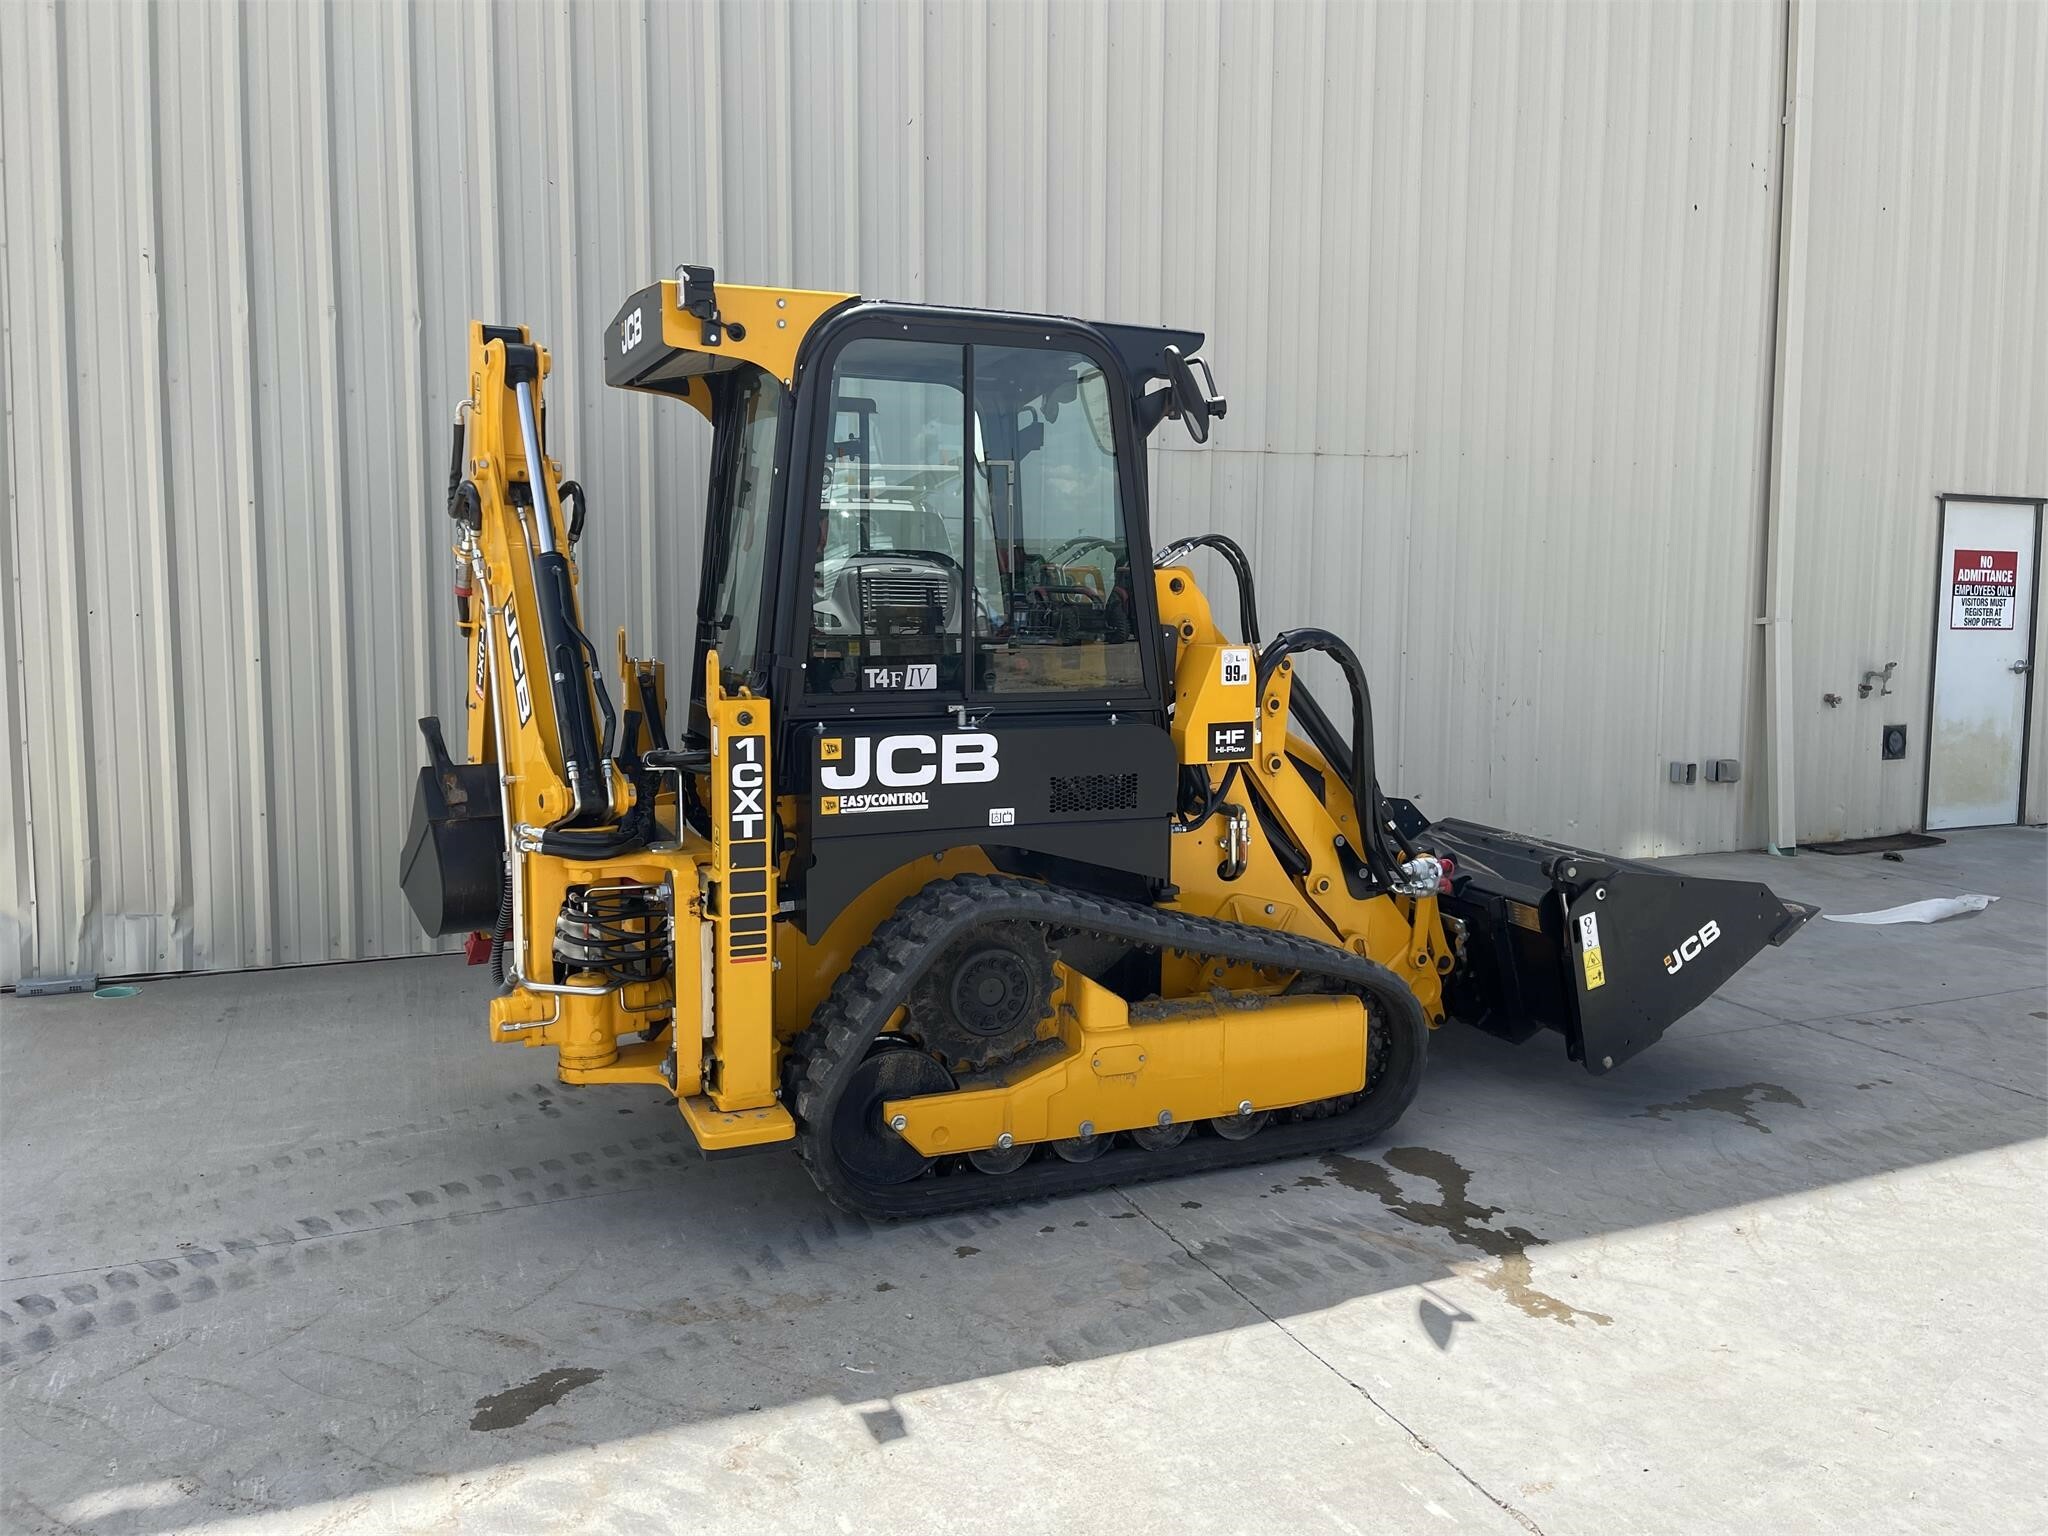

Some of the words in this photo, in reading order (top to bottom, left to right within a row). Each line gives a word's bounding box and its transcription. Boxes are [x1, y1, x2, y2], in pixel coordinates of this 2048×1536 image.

[621, 307, 642, 354] JCB
[1980, 555, 1993, 568] NO
[1957, 569, 2013, 582] ADMITTANCE
[1954, 584, 1995, 596] EMPLOYEES
[1997, 585, 2014, 597] ONLY
[1961, 597, 1988, 606] VISITORS
[1990, 598, 2006, 607] MUST
[1965, 608, 1993, 616] REGISTER
[1994, 608, 2002, 617] AT
[1964, 617, 1980, 626] SHOP
[1982, 618, 2001, 626] OFFICE
[504, 604, 532, 724] JCB
[1225, 665, 1240, 682] 99
[1215, 730, 1245, 745] HF
[821, 733, 1000, 790] JCB
[732, 737, 764, 838] 1CXT
[839, 791, 929, 812] EASYCONTROL
[1667, 919, 1721, 975] JCB
